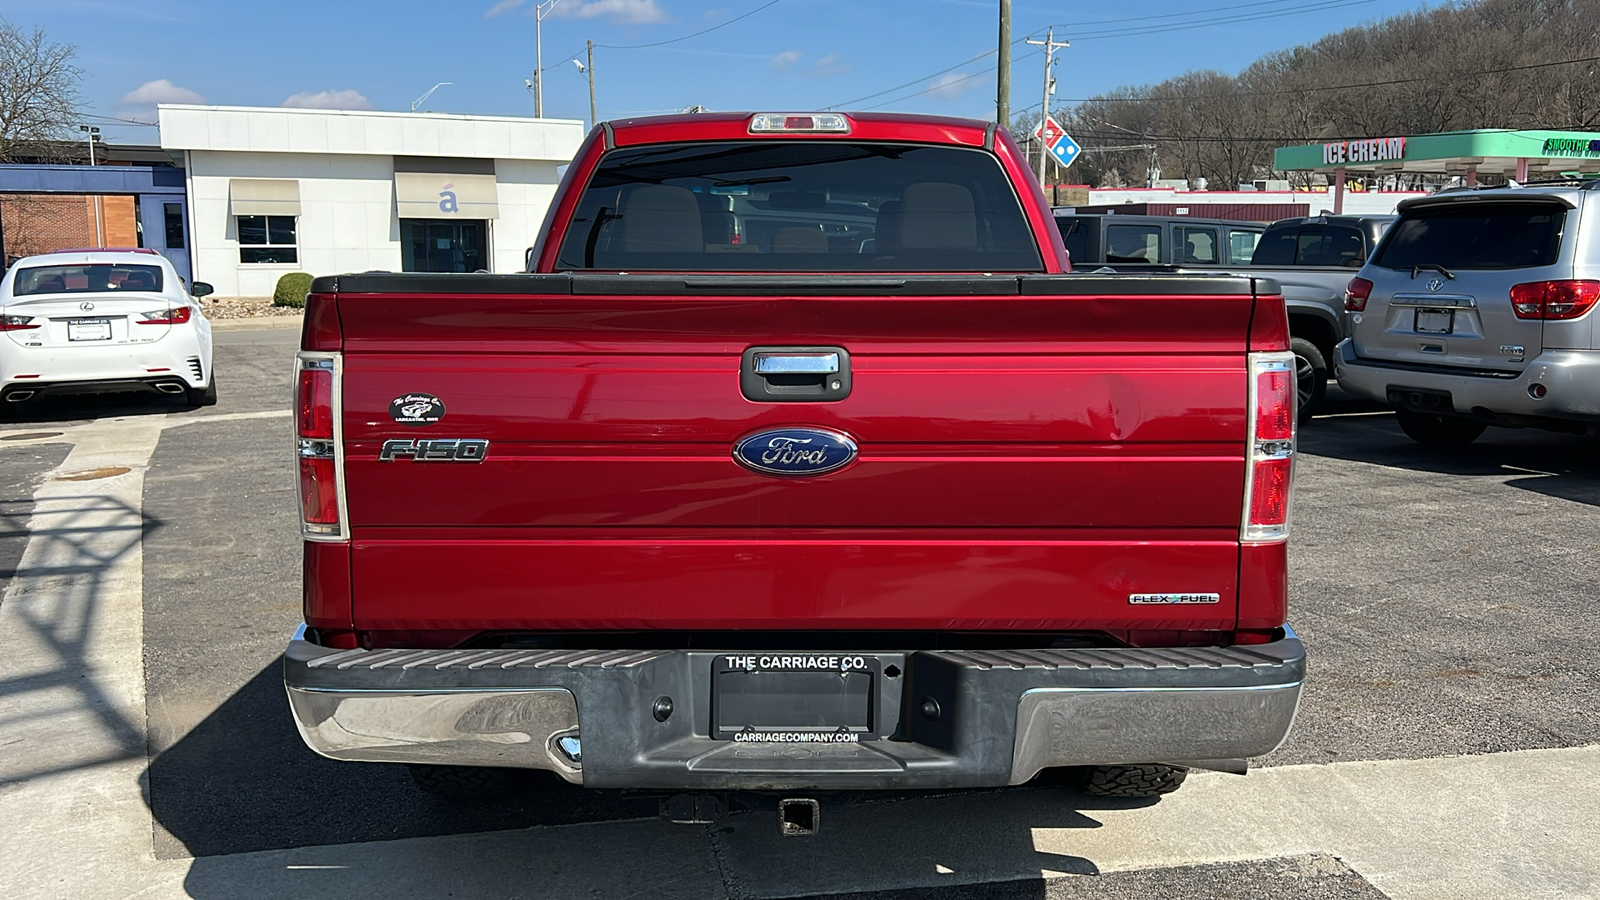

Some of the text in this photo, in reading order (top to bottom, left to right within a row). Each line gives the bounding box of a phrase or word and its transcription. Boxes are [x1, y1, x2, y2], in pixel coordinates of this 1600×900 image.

[1323, 137, 1405, 164] ICE CREAM
[1546, 138, 1589, 151] SMOOTHIE
[379, 439, 489, 463] F-150
[762, 437, 829, 464] Ford
[1133, 595, 1216, 603] FLEX FUEL
[726, 656, 868, 669] THE CARRIAGE CO.
[734, 733, 859, 742] CARRIAGECOMPANY.COM
